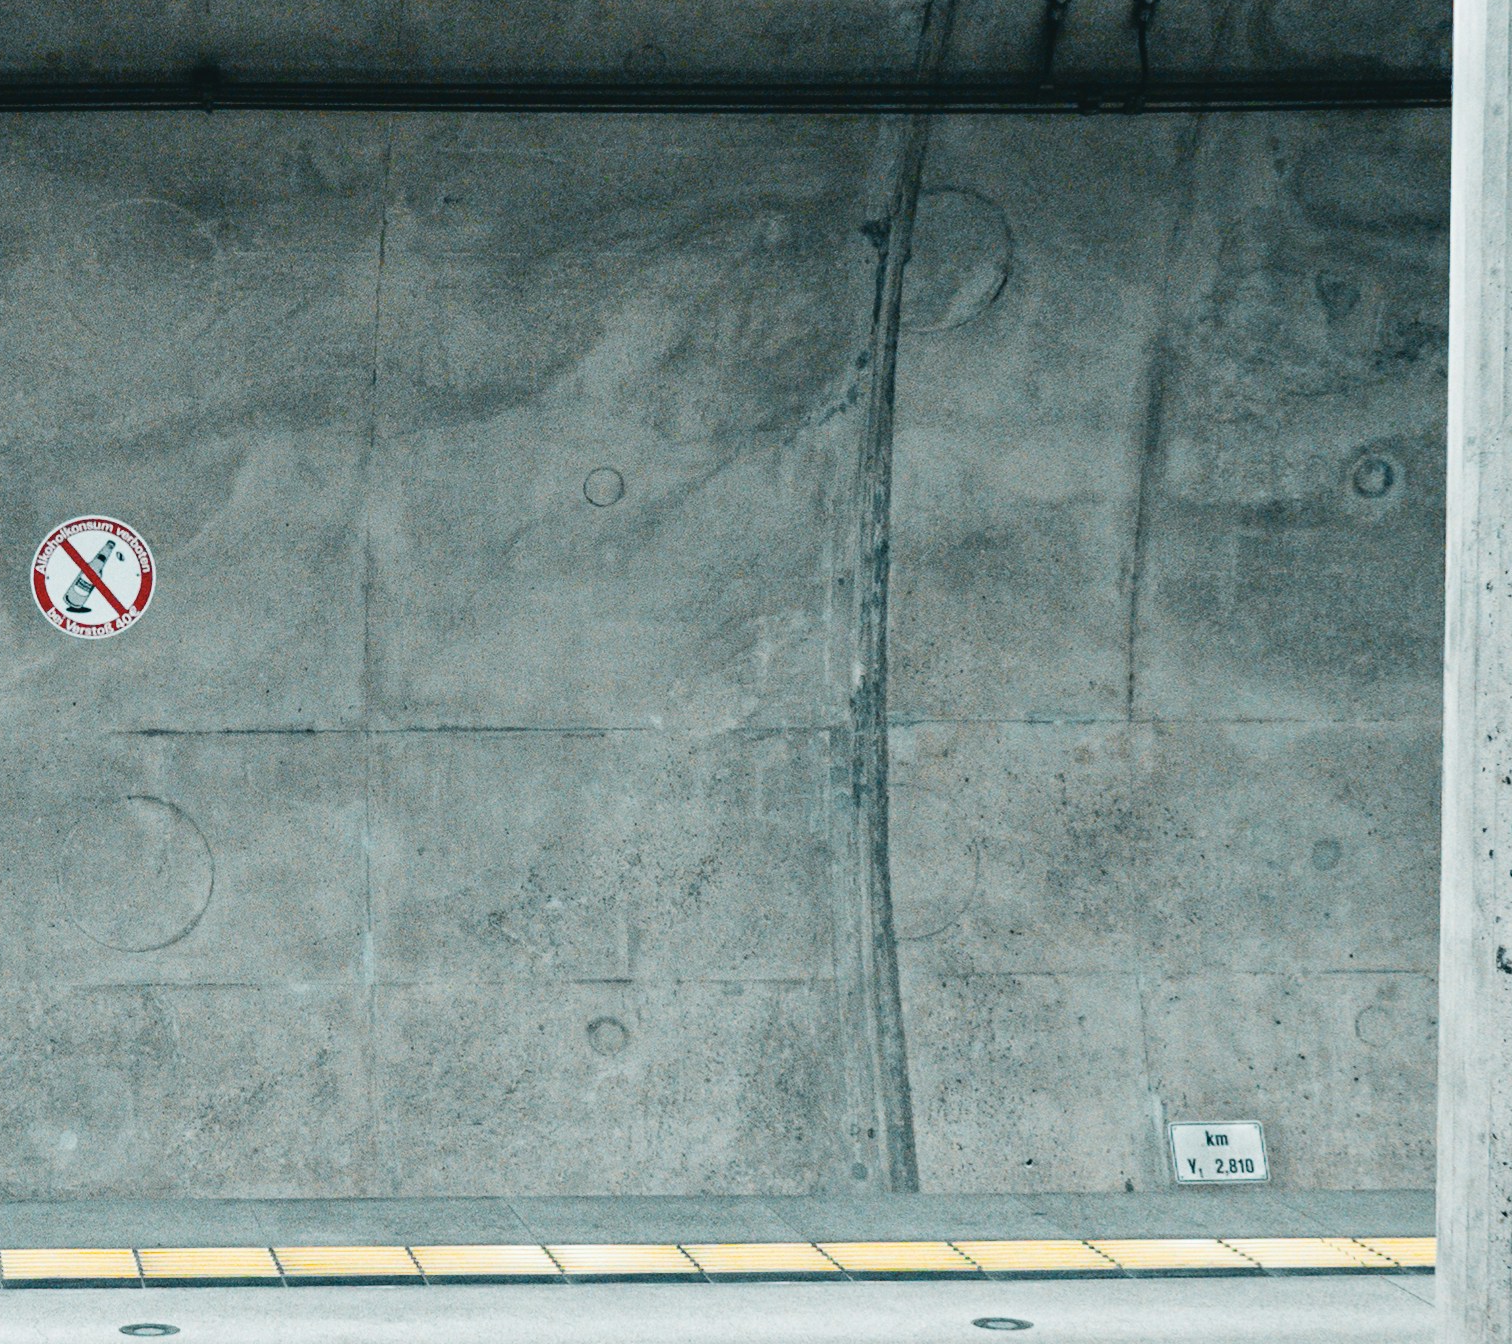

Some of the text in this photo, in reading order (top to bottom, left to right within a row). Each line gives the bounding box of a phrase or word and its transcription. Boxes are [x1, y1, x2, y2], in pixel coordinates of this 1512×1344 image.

[35, 521, 150, 574] Alkoholkonsum verboten
[47, 607, 65, 626] bei
[1205, 1130, 1228, 1146] km
